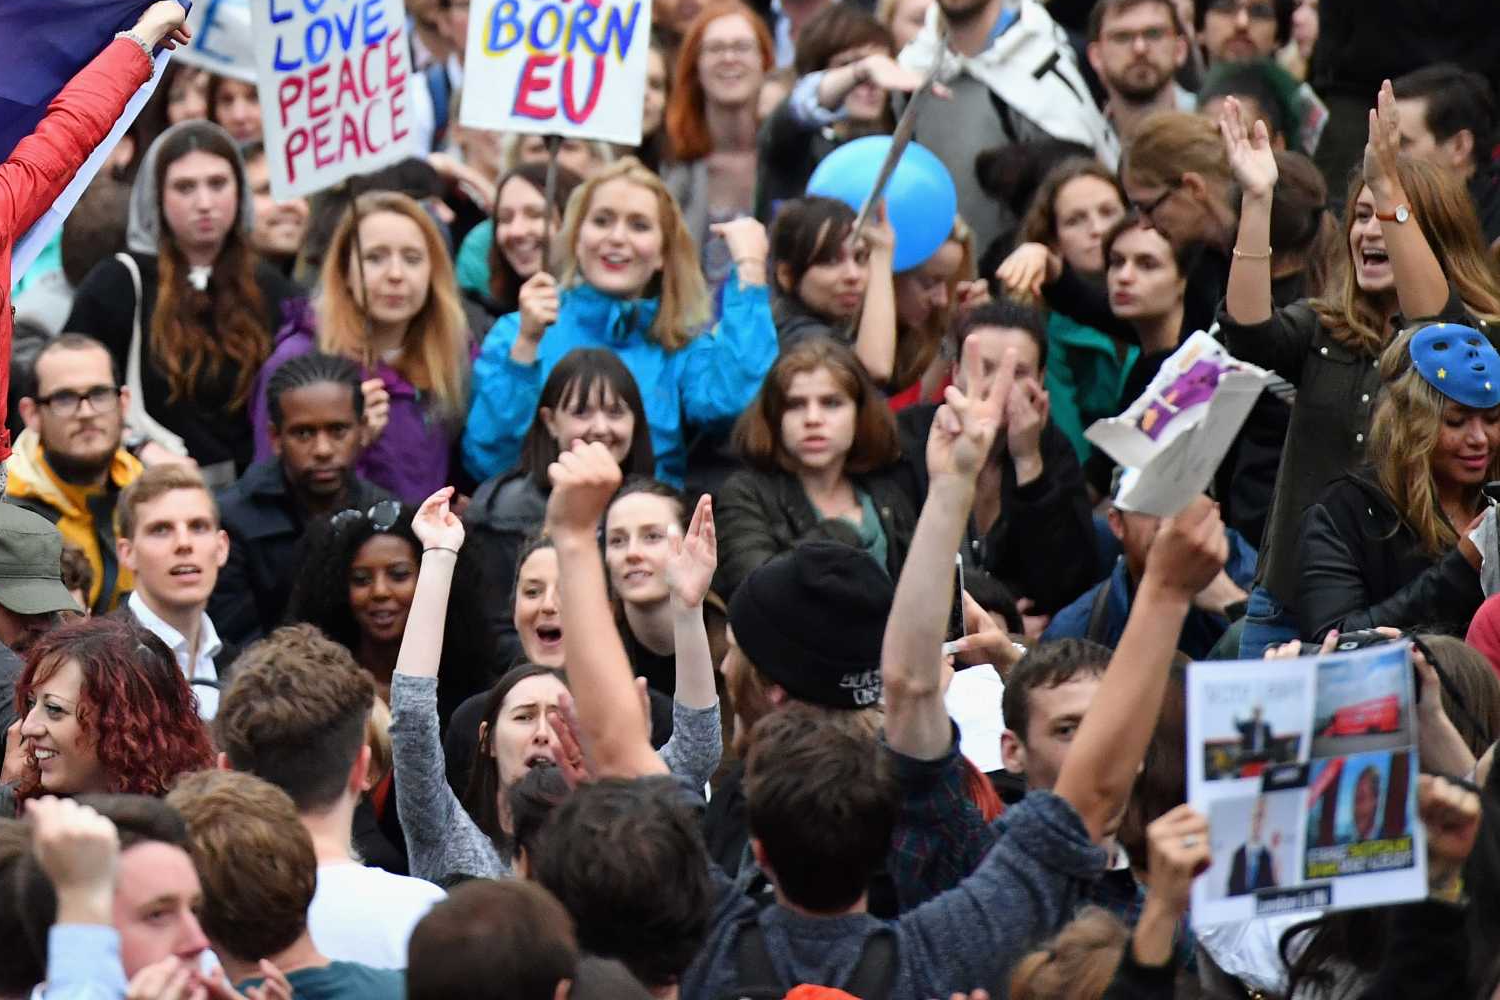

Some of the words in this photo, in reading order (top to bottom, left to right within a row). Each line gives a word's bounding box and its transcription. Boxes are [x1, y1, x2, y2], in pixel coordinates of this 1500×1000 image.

[279, 26, 407, 128] PEACE
[510, 53, 605, 125] EU
[285, 85, 409, 184] PEACE
